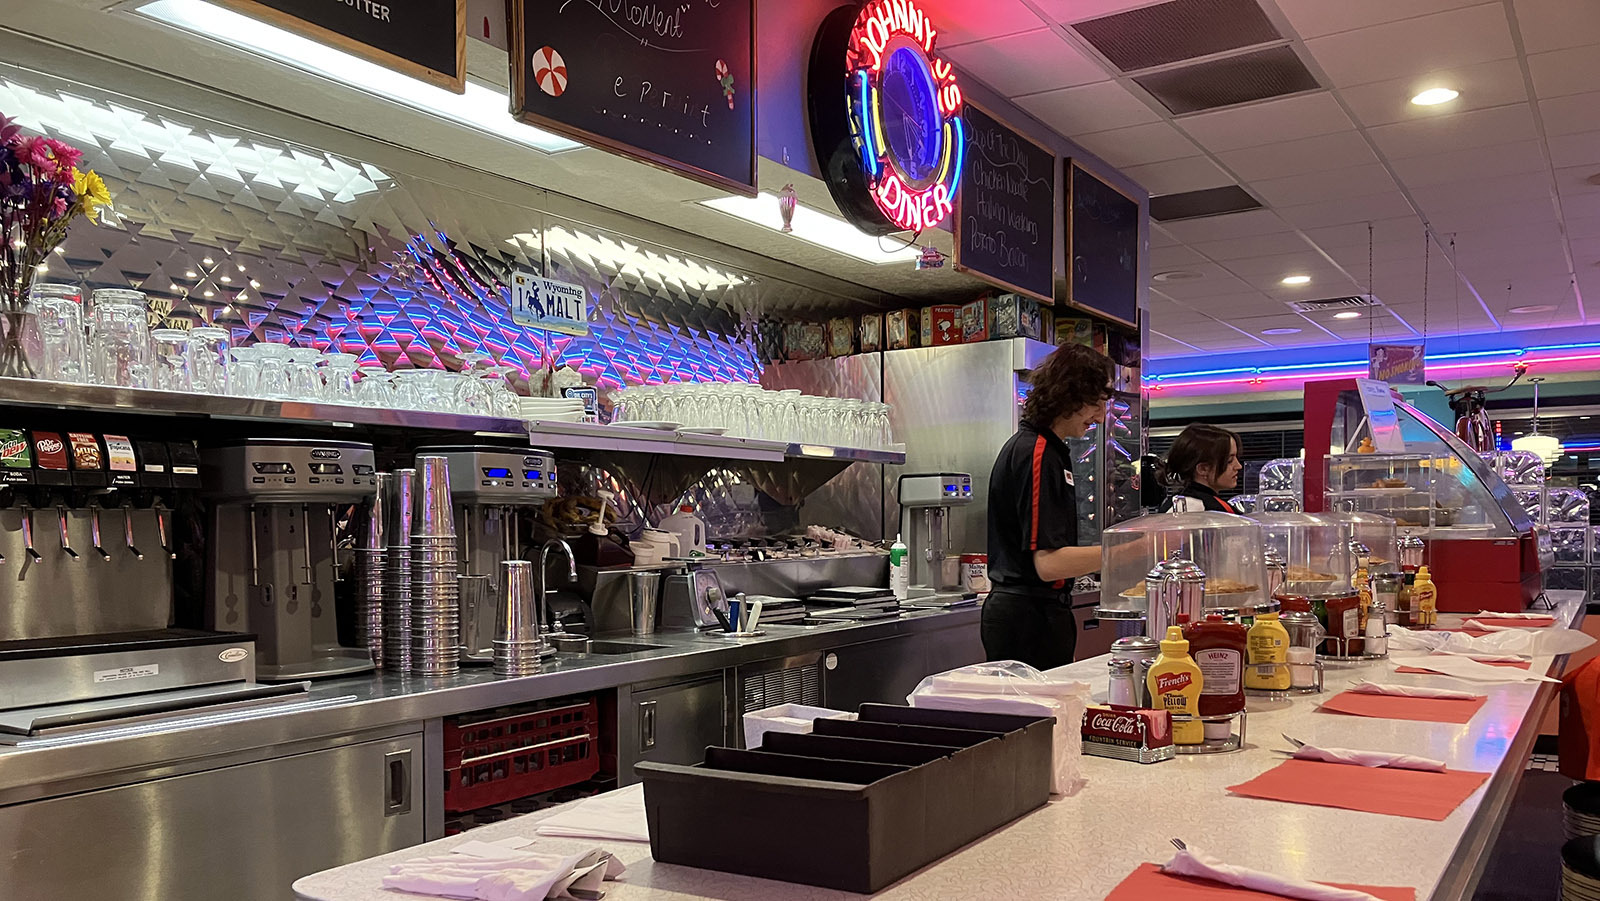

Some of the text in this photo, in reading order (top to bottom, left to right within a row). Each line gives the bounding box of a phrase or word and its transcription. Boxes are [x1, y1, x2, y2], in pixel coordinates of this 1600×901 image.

[336, 0, 390, 23] UTTER
[860, 0, 937, 70] JOHNNY
[879, 175, 953, 232] DINER
[543, 280, 583, 299] Wyoming
[546, 293, 582, 321] MALT
[1208, 652, 1229, 660] HEINZ
[1160, 673, 1190, 689] French's
[1163, 696, 1187, 706] YELLOW
